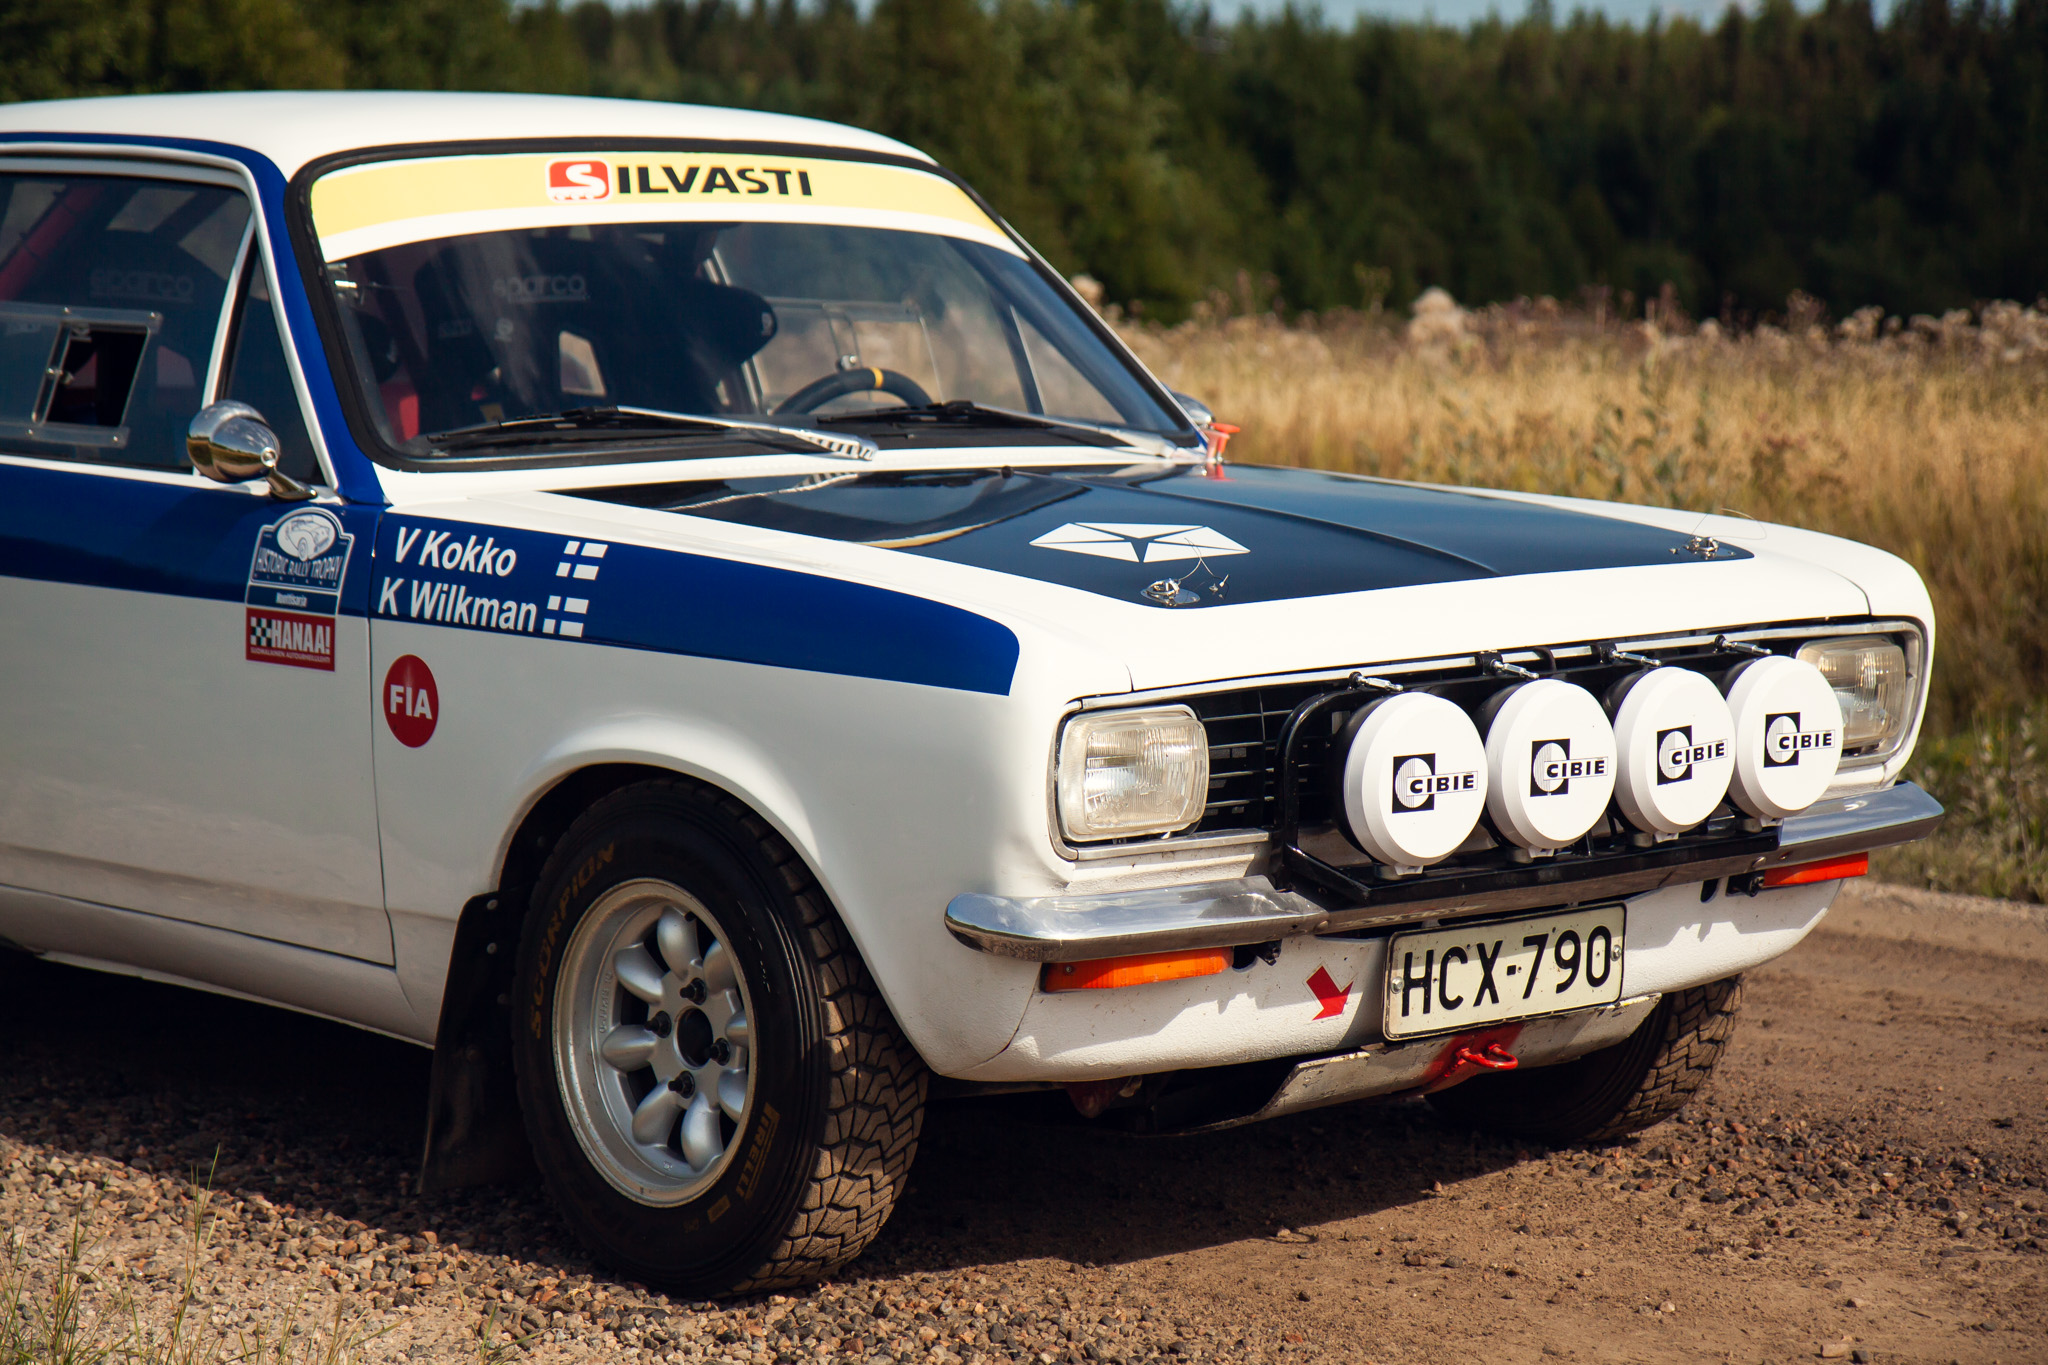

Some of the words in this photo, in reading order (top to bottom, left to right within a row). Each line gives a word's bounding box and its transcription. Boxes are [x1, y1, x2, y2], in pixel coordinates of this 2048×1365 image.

[550, 160, 813, 199] SILVASTI
[288, 559, 312, 577] RALLY
[311, 555, 343, 581] TROPHY
[395, 526, 421, 563] V
[418, 529, 517, 577] Kokko
[378, 576, 404, 616] K
[411, 579, 537, 633] Wilkman
[271, 618, 331, 655] HANAA!
[390, 684, 433, 720] FIA
[530, 840, 615, 1040] SCORPION
[1401, 925, 1612, 1018] HCX-790
